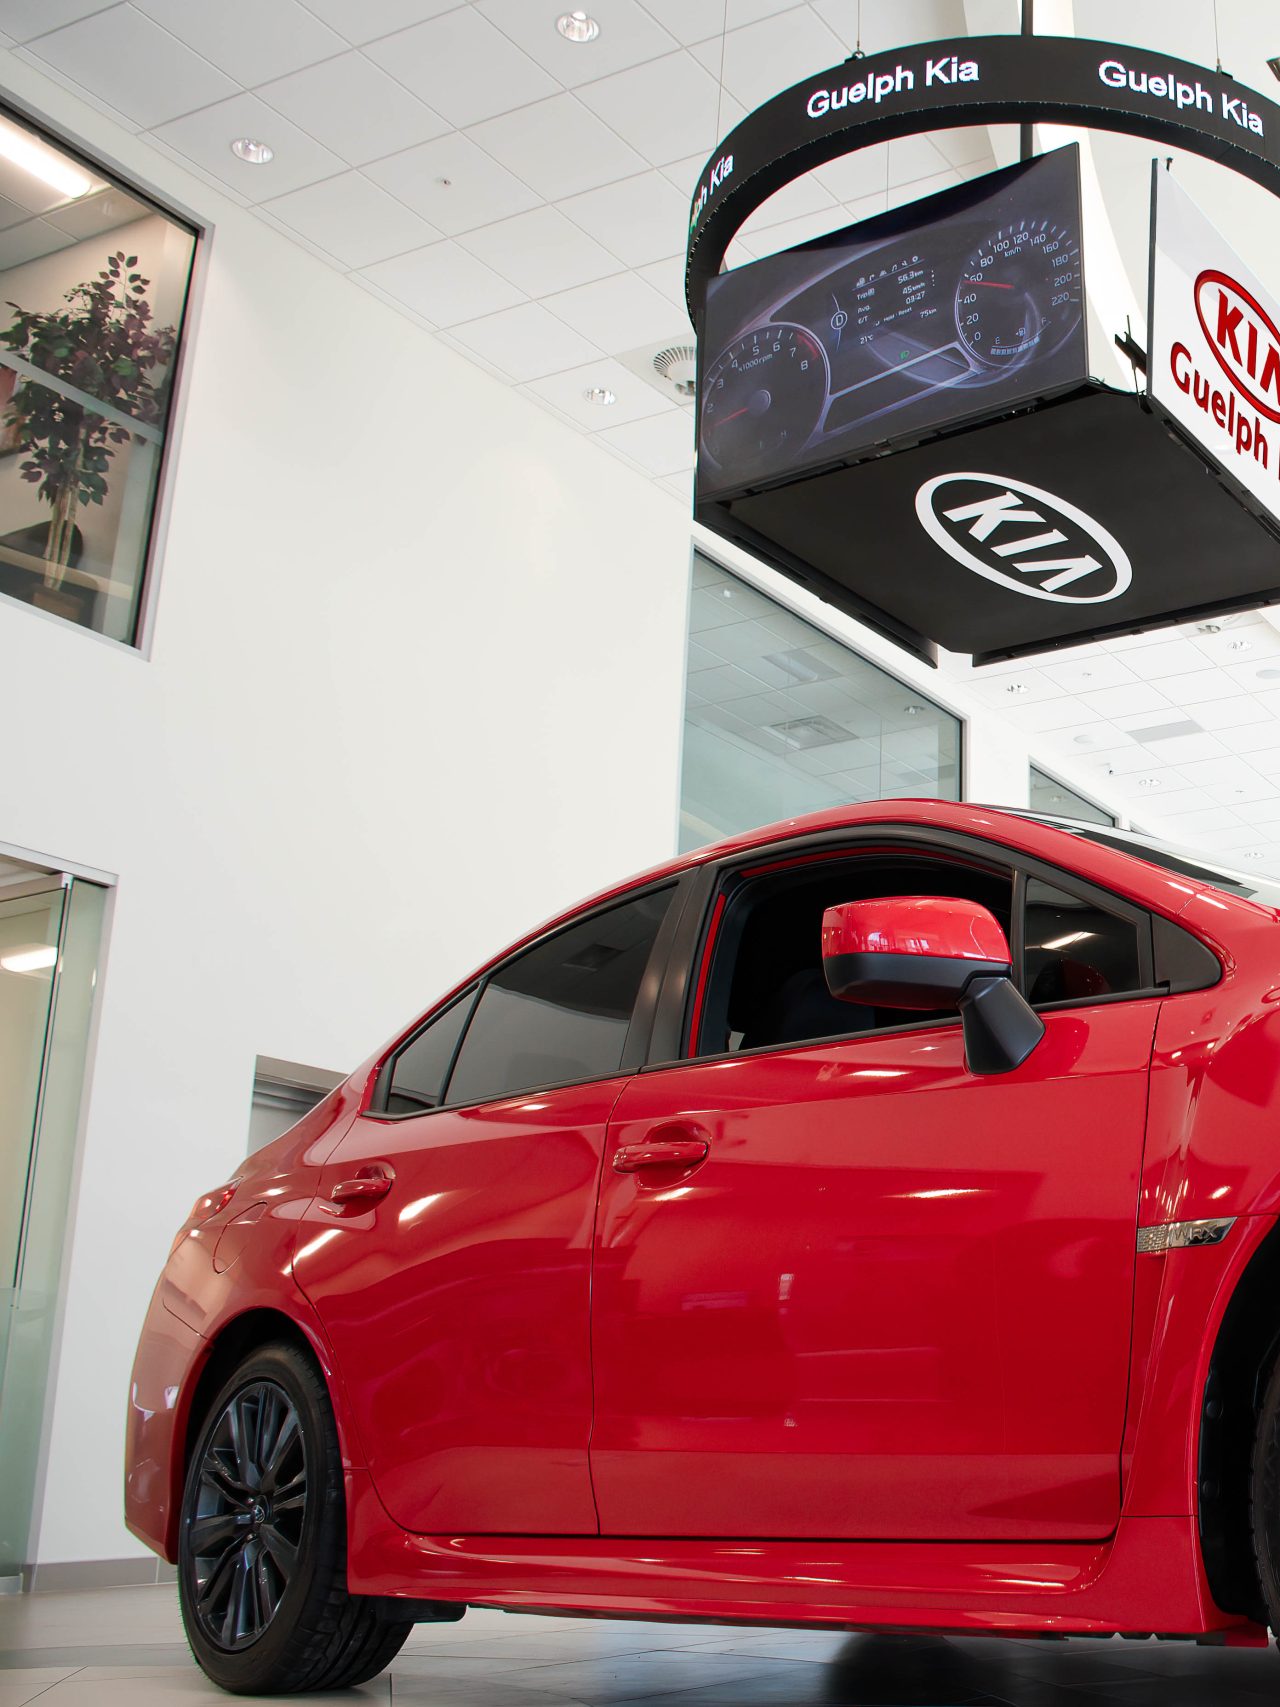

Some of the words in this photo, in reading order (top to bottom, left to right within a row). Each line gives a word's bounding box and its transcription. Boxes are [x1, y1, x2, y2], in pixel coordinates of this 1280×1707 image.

[806, 65, 914, 118] Guelph
[925, 56, 979, 87] Kia
[1098, 60, 1213, 114] Guelph
[1221, 92, 1264, 137] Kia
[709, 154, 734, 196] Kia
[1013, 231, 1029, 245] 120
[1030, 233, 1046, 247] 140
[993, 240, 1010, 253] 100
[1004, 246, 1022, 257] km/h
[1042, 241, 1059, 254] 160
[980, 255, 993, 267] 80
[1052, 254, 1069, 268] 180
[970, 272, 983, 282] 60
[1054, 272, 1072, 287] 200
[963, 293, 977, 304] 40
[1051, 291, 1070, 306] 220
[835, 314, 844, 327] D
[966, 312, 979, 325] 20
[974, 331, 981, 341] 0
[752, 345, 760, 356] 5
[772, 341, 780, 352] 6
[789, 347, 796, 357] 7
[731, 359, 738, 369] 4
[800, 359, 808, 371] 8
[717, 378, 724, 389] 3
[1170, 341, 1269, 470] Guelph
[942, 491, 1103, 593] KIA
[1173, 1227, 1218, 1240] WRX
